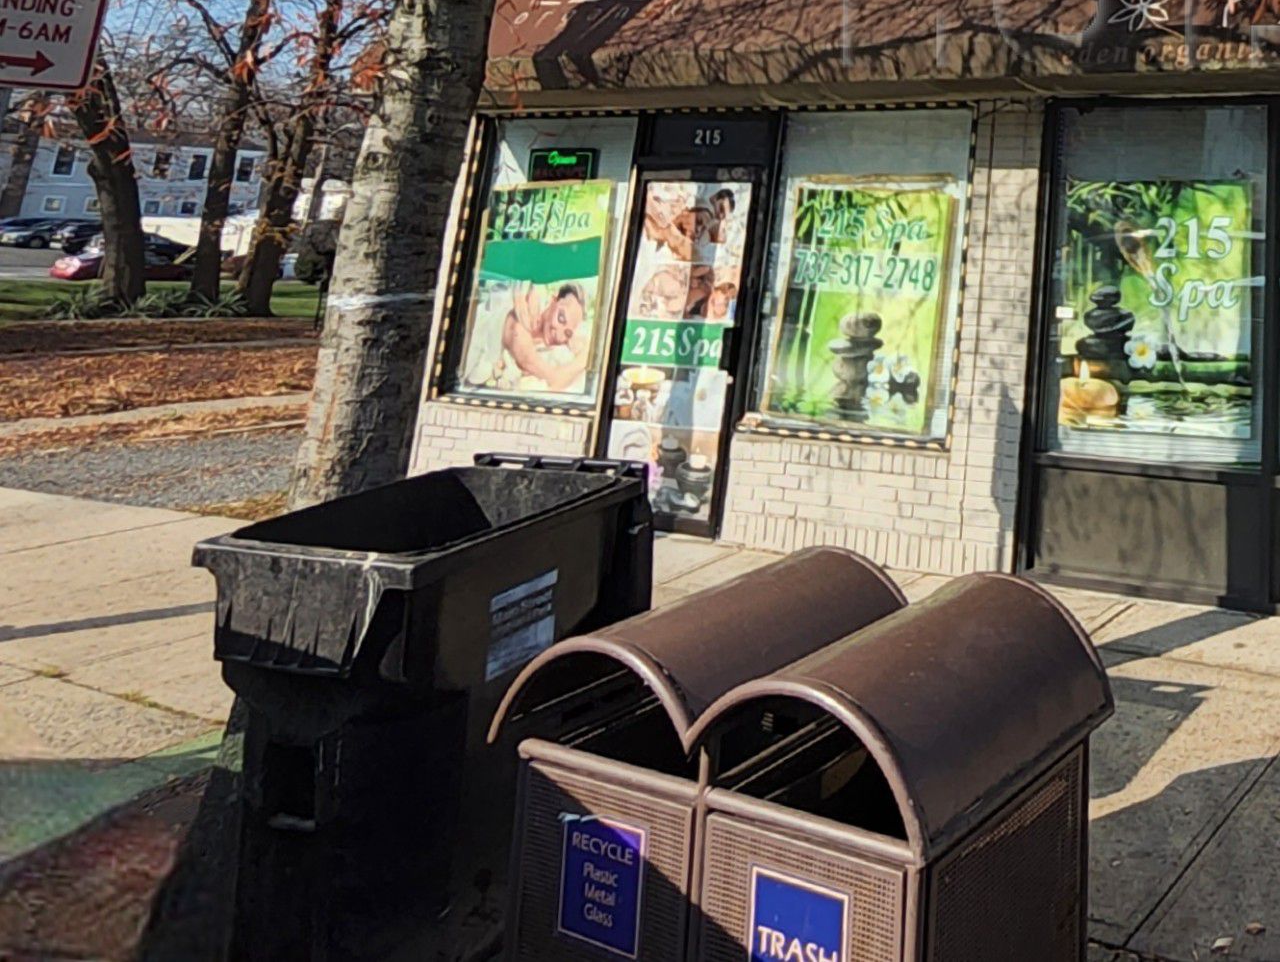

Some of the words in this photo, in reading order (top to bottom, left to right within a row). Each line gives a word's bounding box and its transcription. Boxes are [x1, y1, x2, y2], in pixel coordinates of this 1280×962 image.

[694, 129, 721, 145] 215
[505, 202, 547, 233] 215
[818, 206, 866, 238] 215
[870, 202, 931, 250] Spa
[1153, 216, 1233, 259] 215
[794, 249, 937, 292] 732-317-2748
[1148, 262, 1239, 322] Spa
[630, 326, 677, 357] 215
[678, 326, 724, 366] Spa
[571, 831, 635, 866] RECYCLE
[583, 861, 619, 888] Plastic
[584, 882, 617, 906] Metal
[583, 902, 614, 928] Glass
